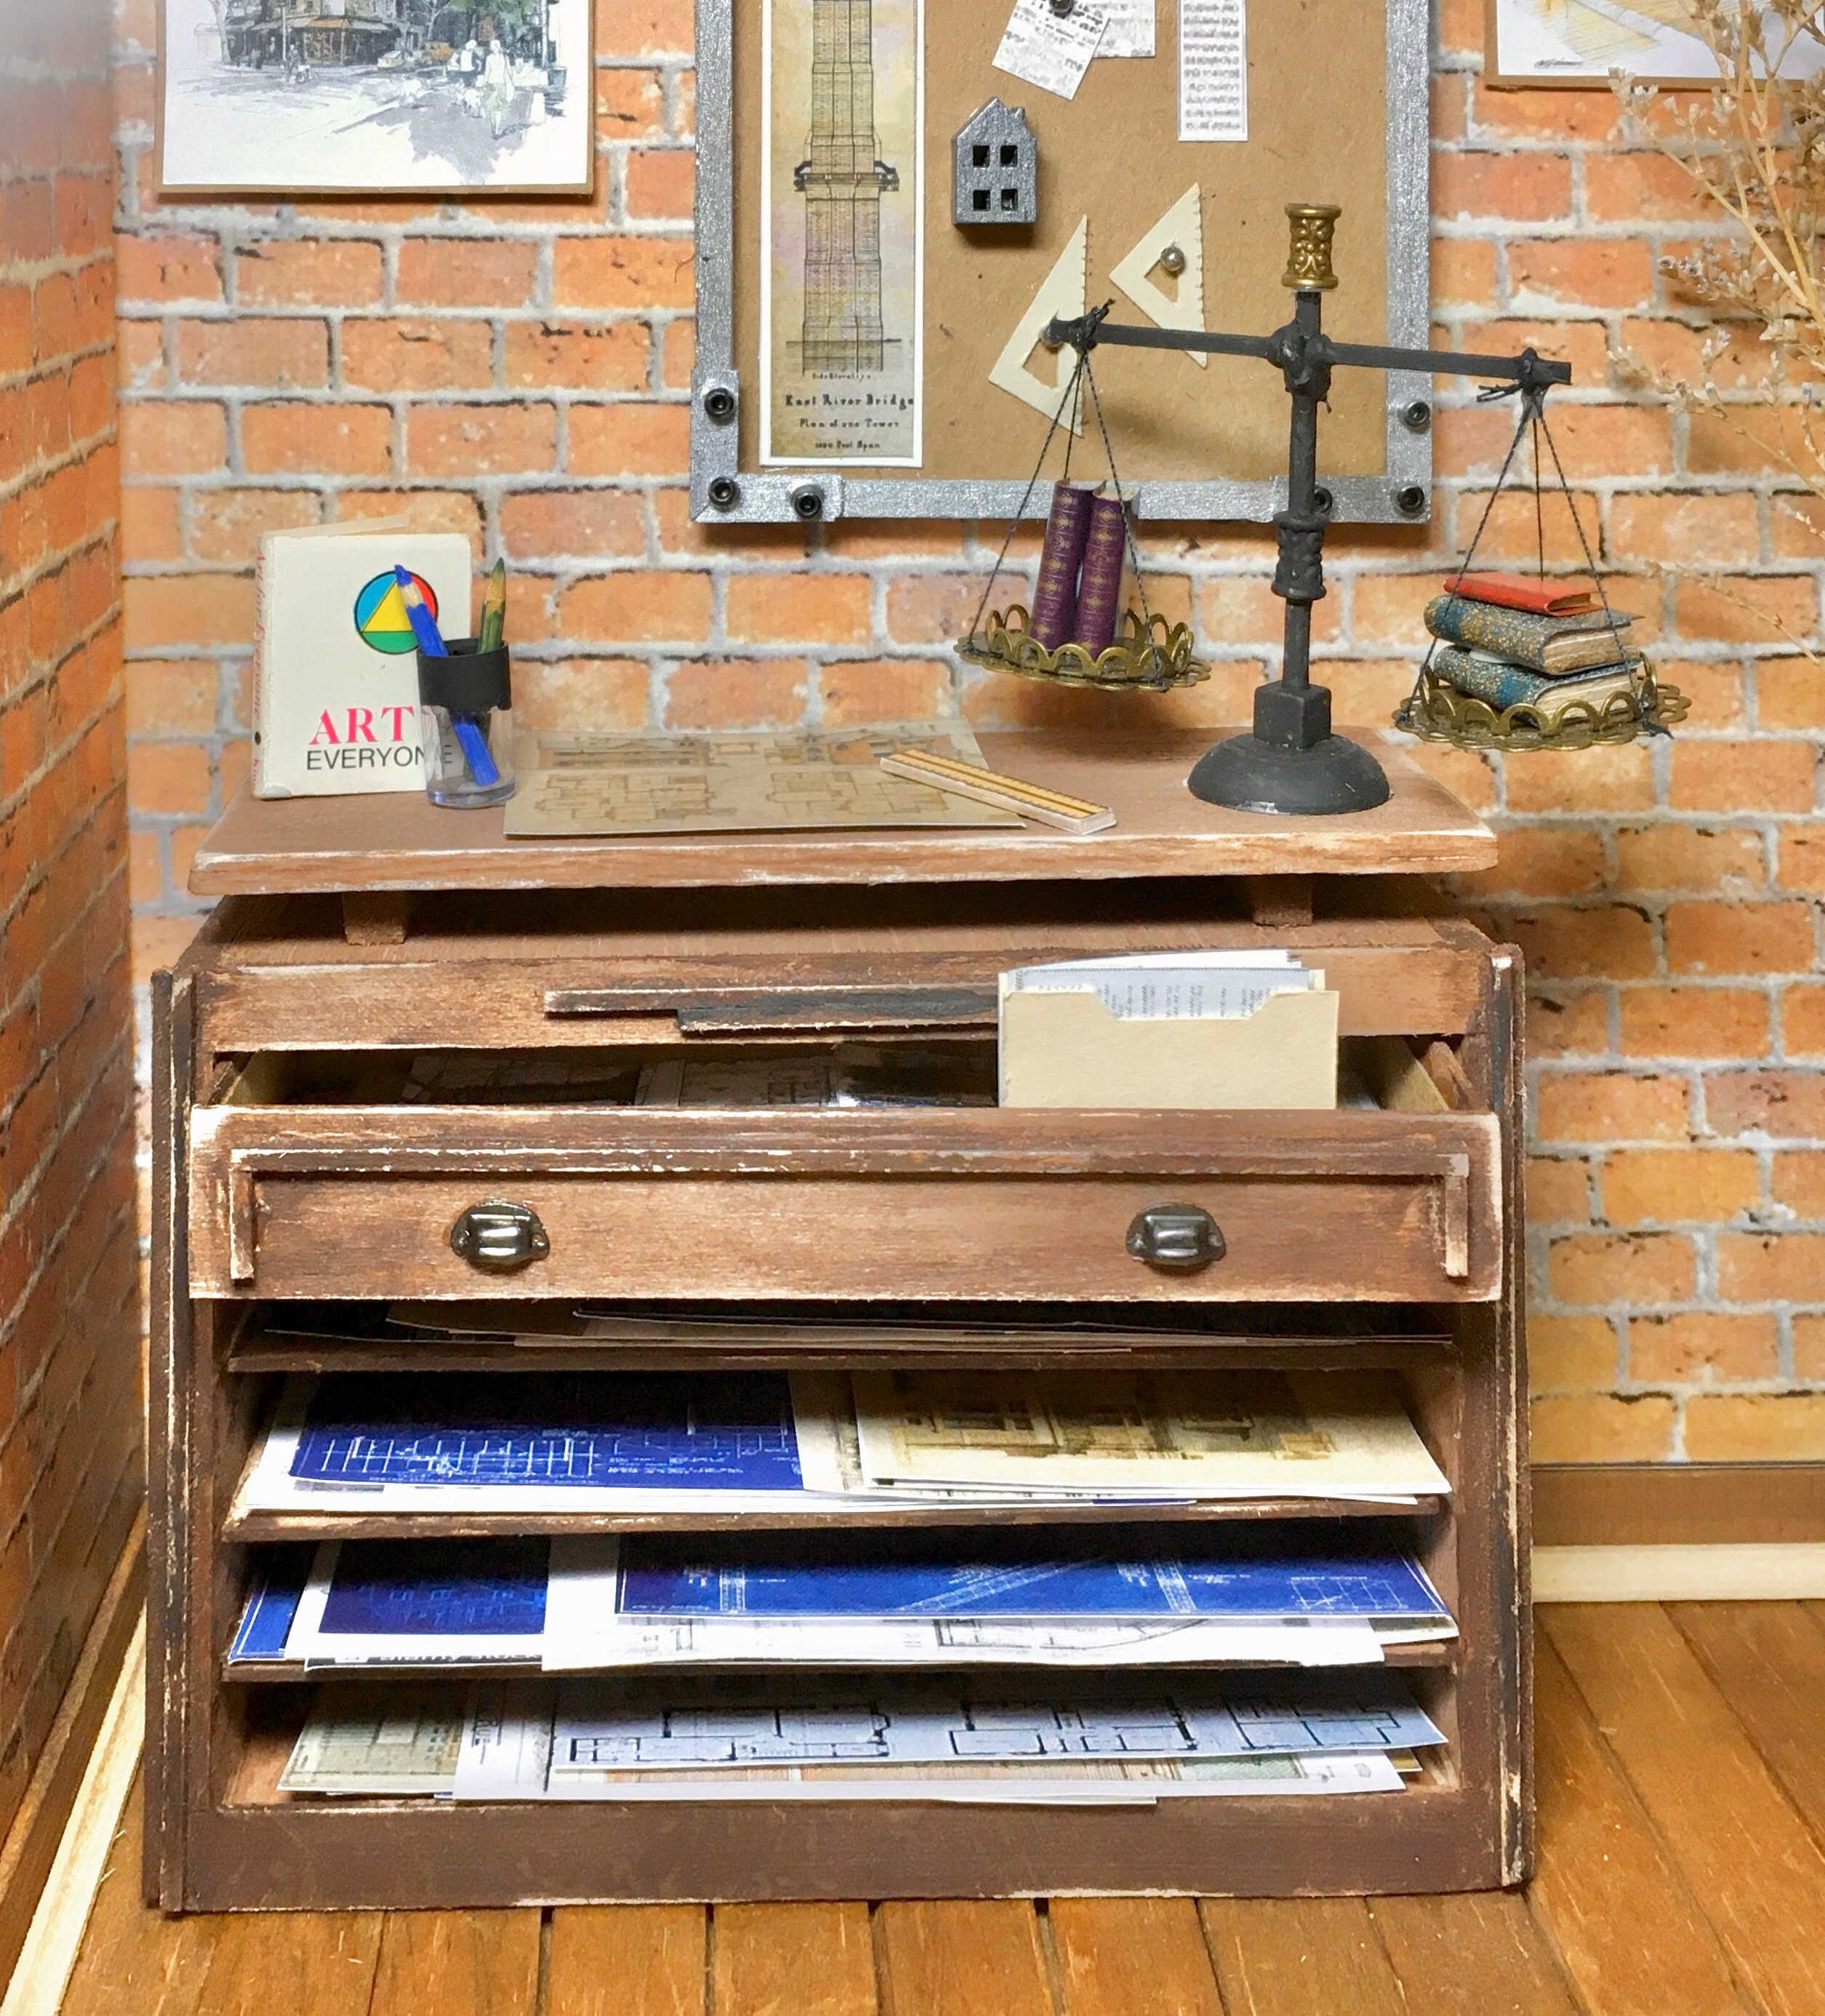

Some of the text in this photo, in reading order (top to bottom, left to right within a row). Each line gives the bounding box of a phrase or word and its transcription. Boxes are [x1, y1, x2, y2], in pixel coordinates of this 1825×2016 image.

[822, 393, 862, 406] River
[865, 393, 914, 411] Bridge
[799, 418, 825, 428] Plan
[829, 419, 838, 428] of
[864, 418, 899, 428] Tower
[308, 705, 414, 745] ART
